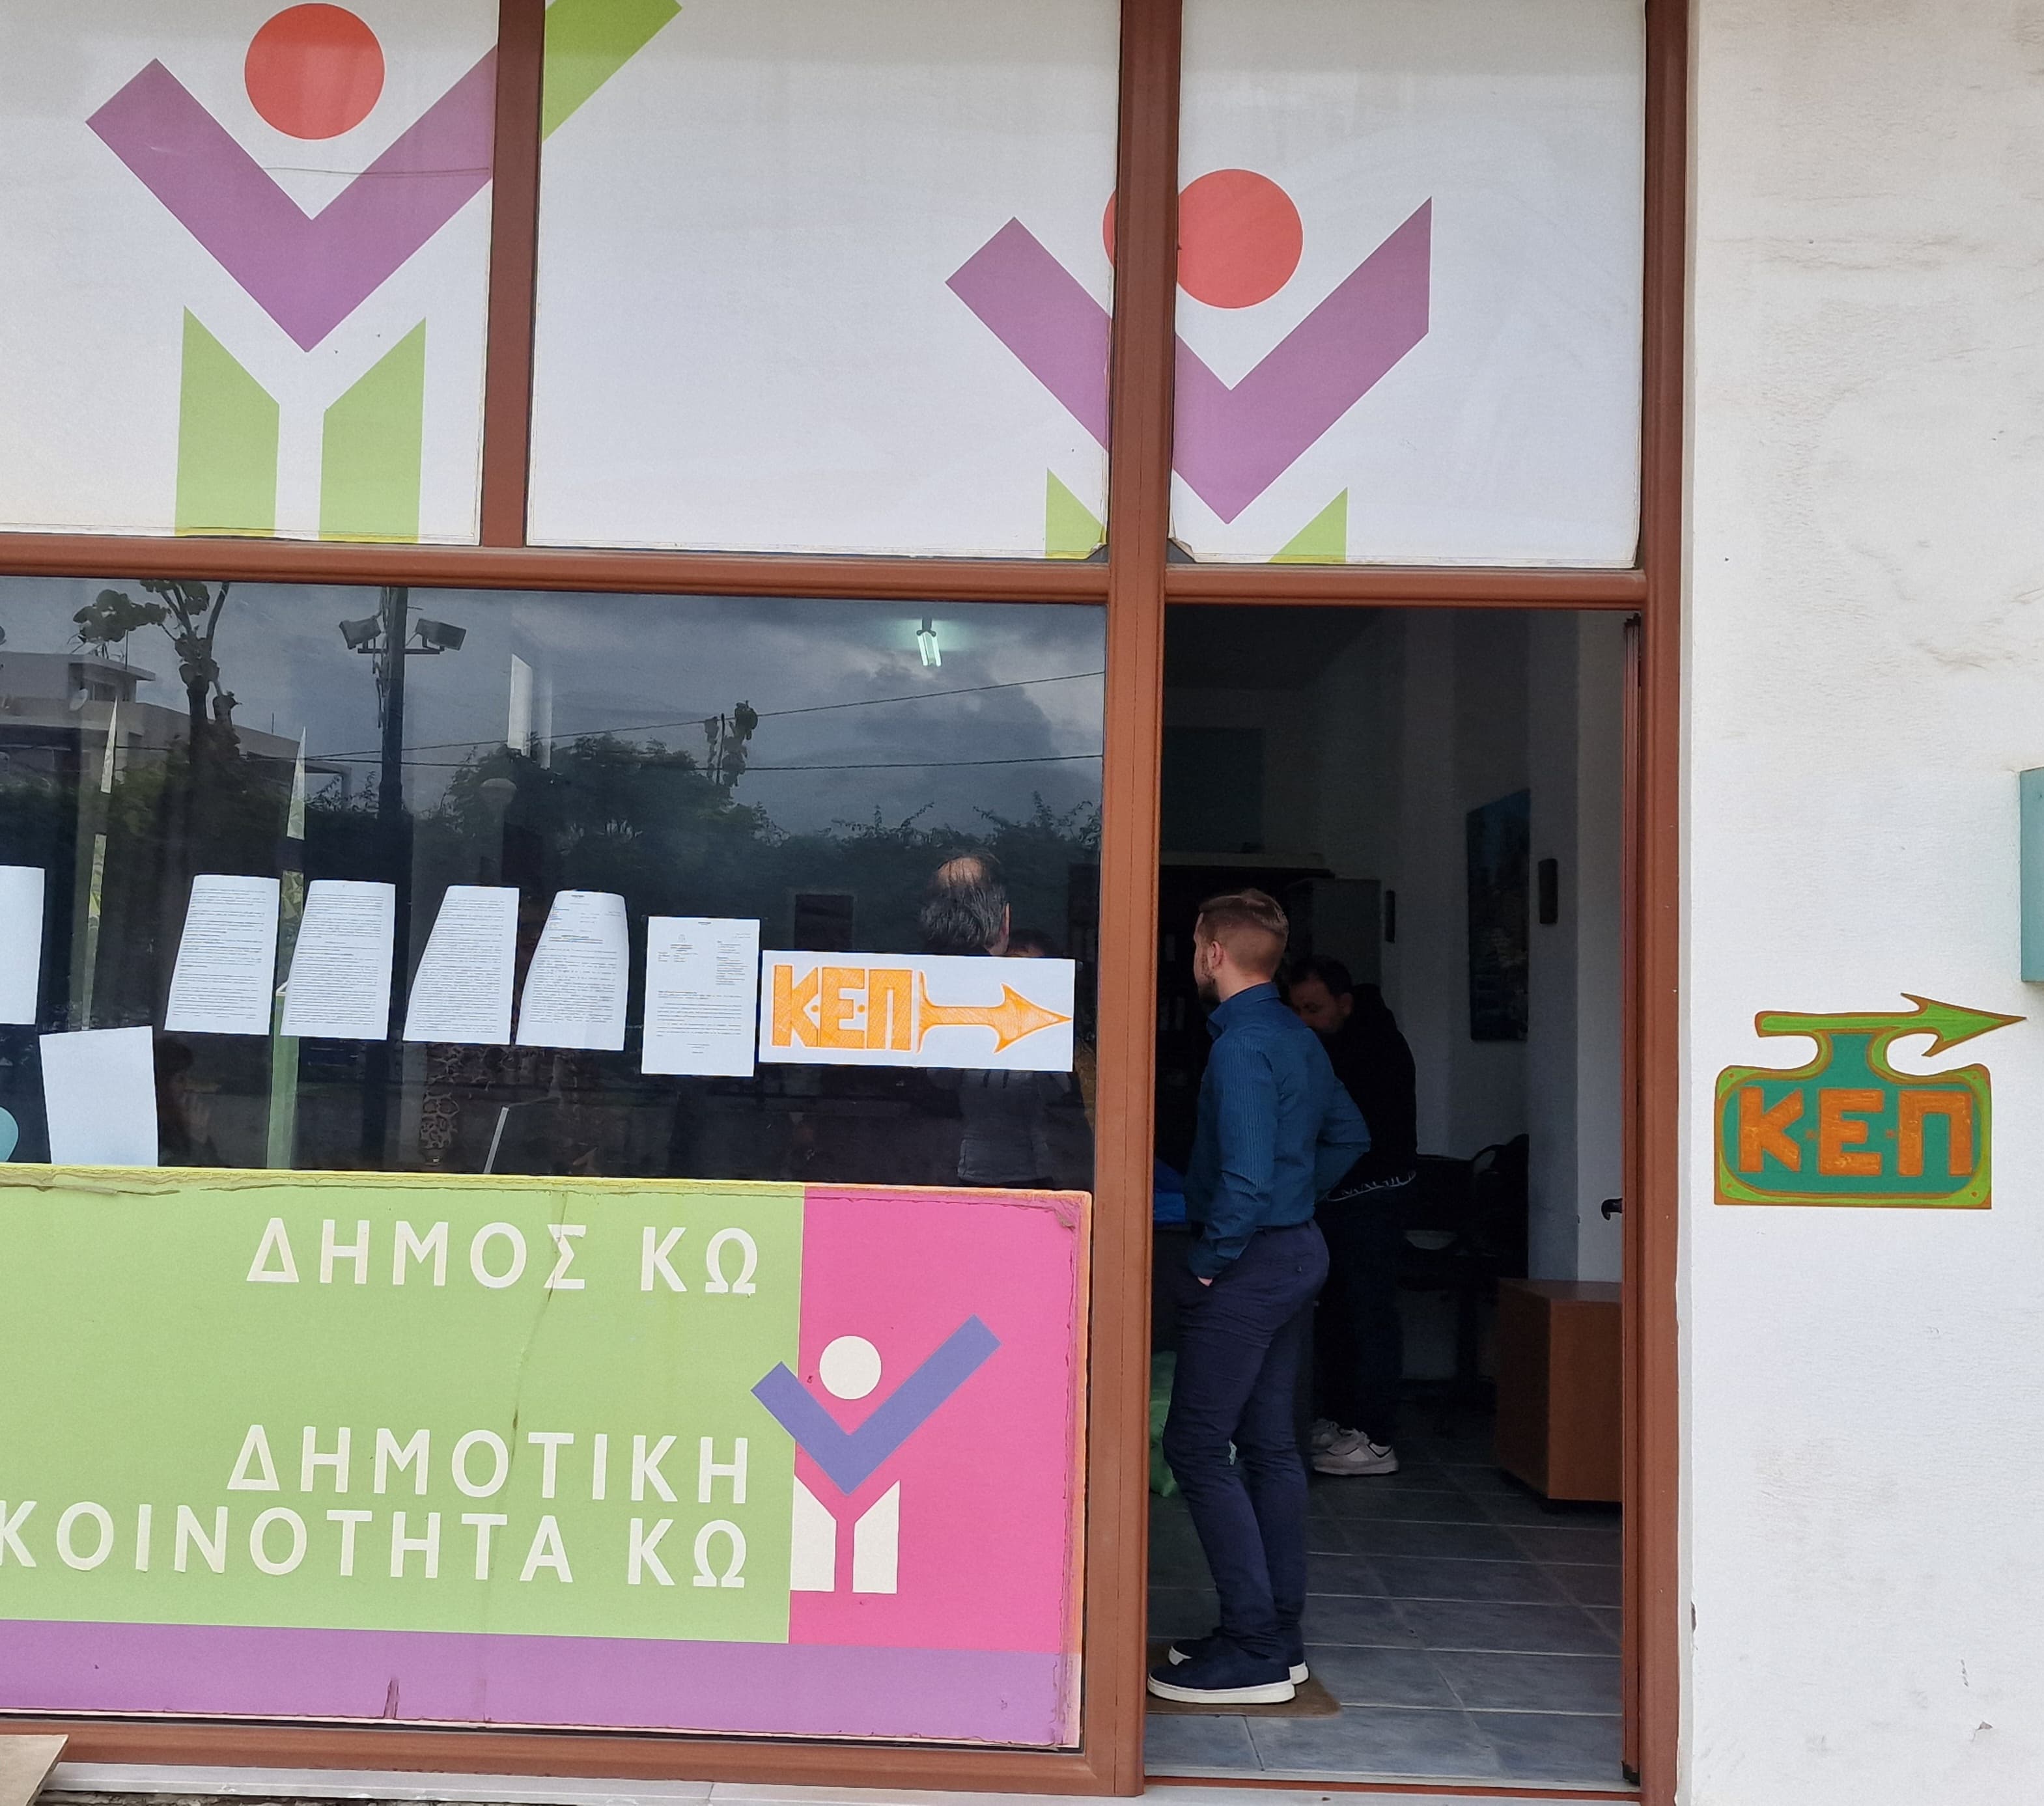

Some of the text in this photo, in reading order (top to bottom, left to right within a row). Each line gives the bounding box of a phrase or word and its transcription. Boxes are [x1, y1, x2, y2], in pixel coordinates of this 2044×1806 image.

[245, 1217, 760, 1295] ΔΗΜΟΣ ΚΩ
[226, 1424, 749, 1505] ΔΗΜΟΤΙΚΗ
[0, 1499, 748, 1589] ΚΟΙΝΟΤΗΤΑ ΚΩ
